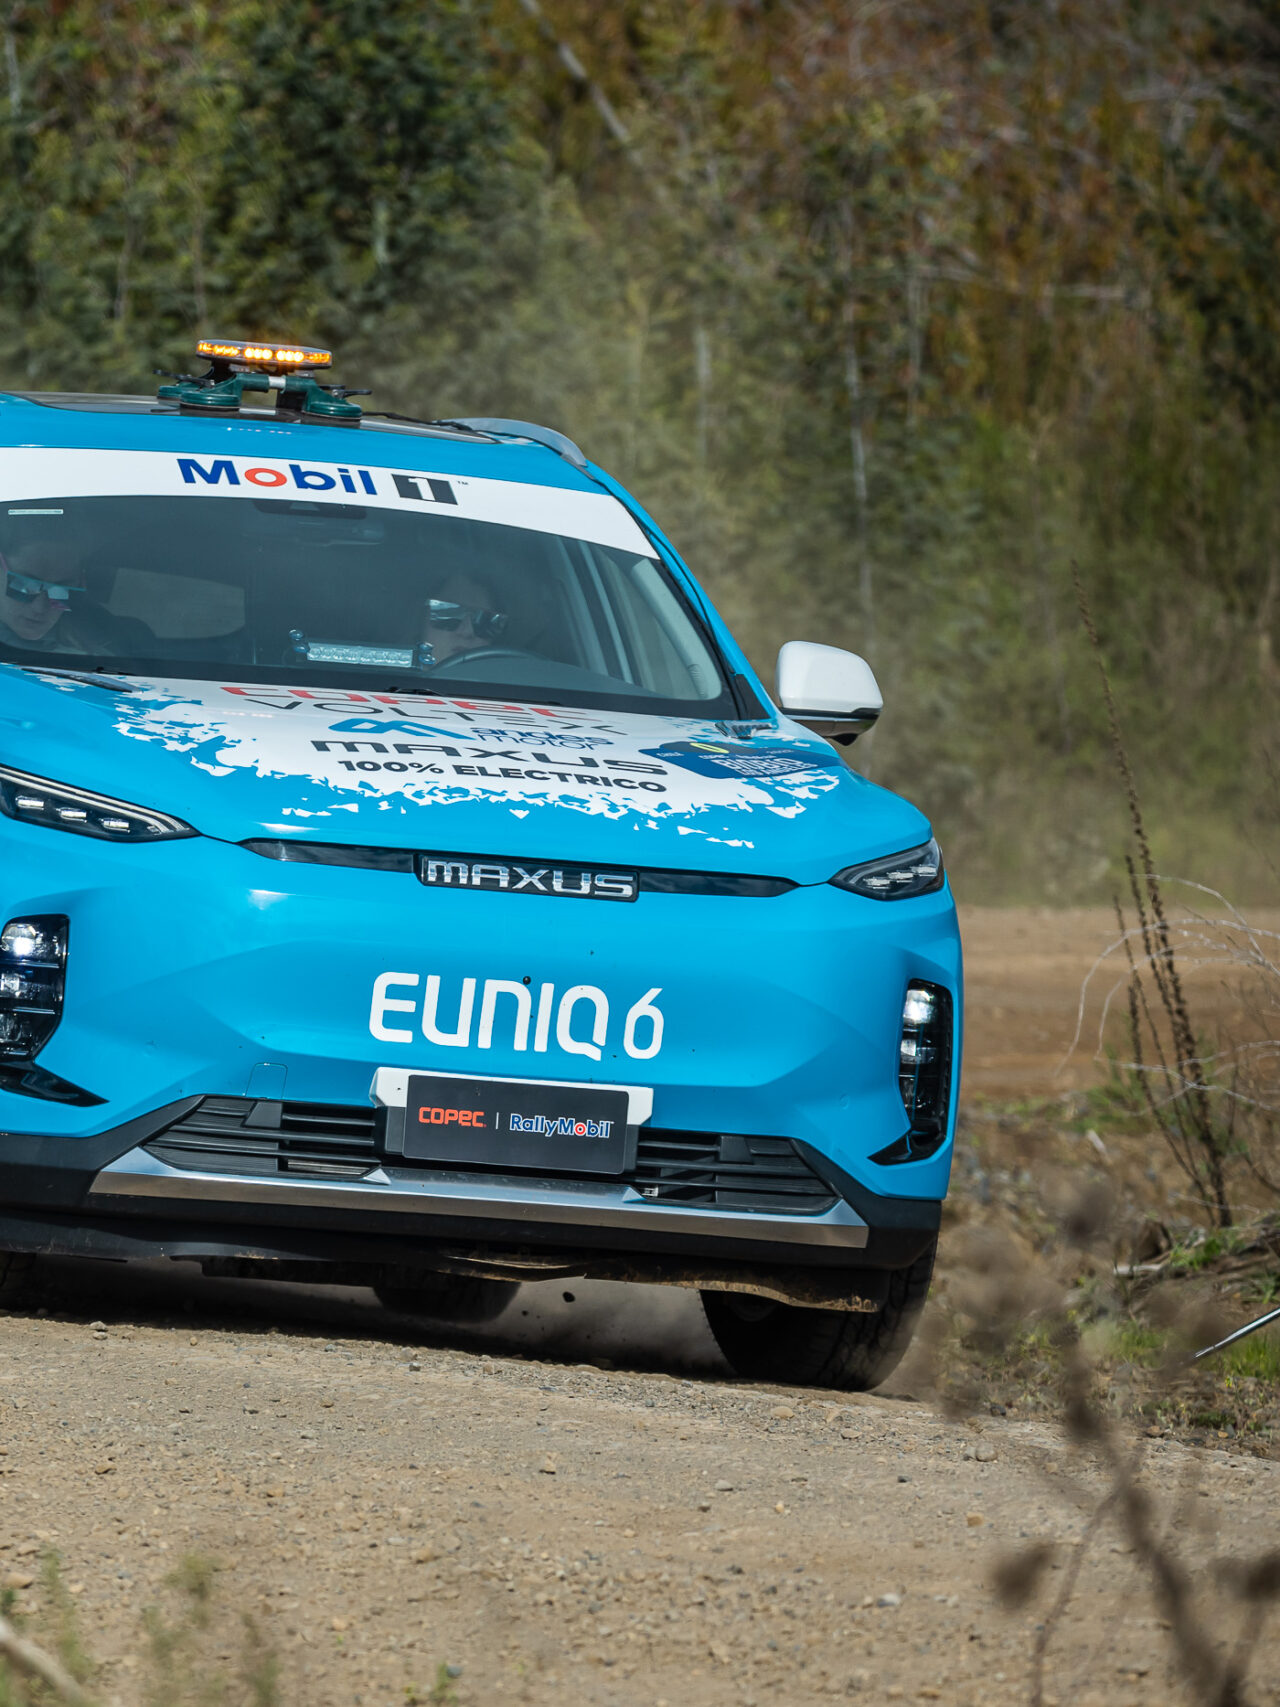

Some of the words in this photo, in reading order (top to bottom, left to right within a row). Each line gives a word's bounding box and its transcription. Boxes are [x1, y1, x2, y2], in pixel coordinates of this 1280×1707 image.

[177, 458, 377, 495] Mobil
[221, 686, 602, 722] COPEC
[244, 699, 628, 736] VOLTEX
[470, 727, 615, 745] andes
[478, 734, 596, 751] motor
[311, 740, 668, 776] MAXUS
[338, 760, 444, 775] 100%
[452, 764, 667, 793] ELECTRICO
[427, 860, 634, 898] MAXUS
[369, 971, 610, 1061] EUNIQ
[623, 987, 665, 1060] 6
[418, 1106, 486, 1128] COPEC
[509, 1113, 612, 1139] RallyMobil
